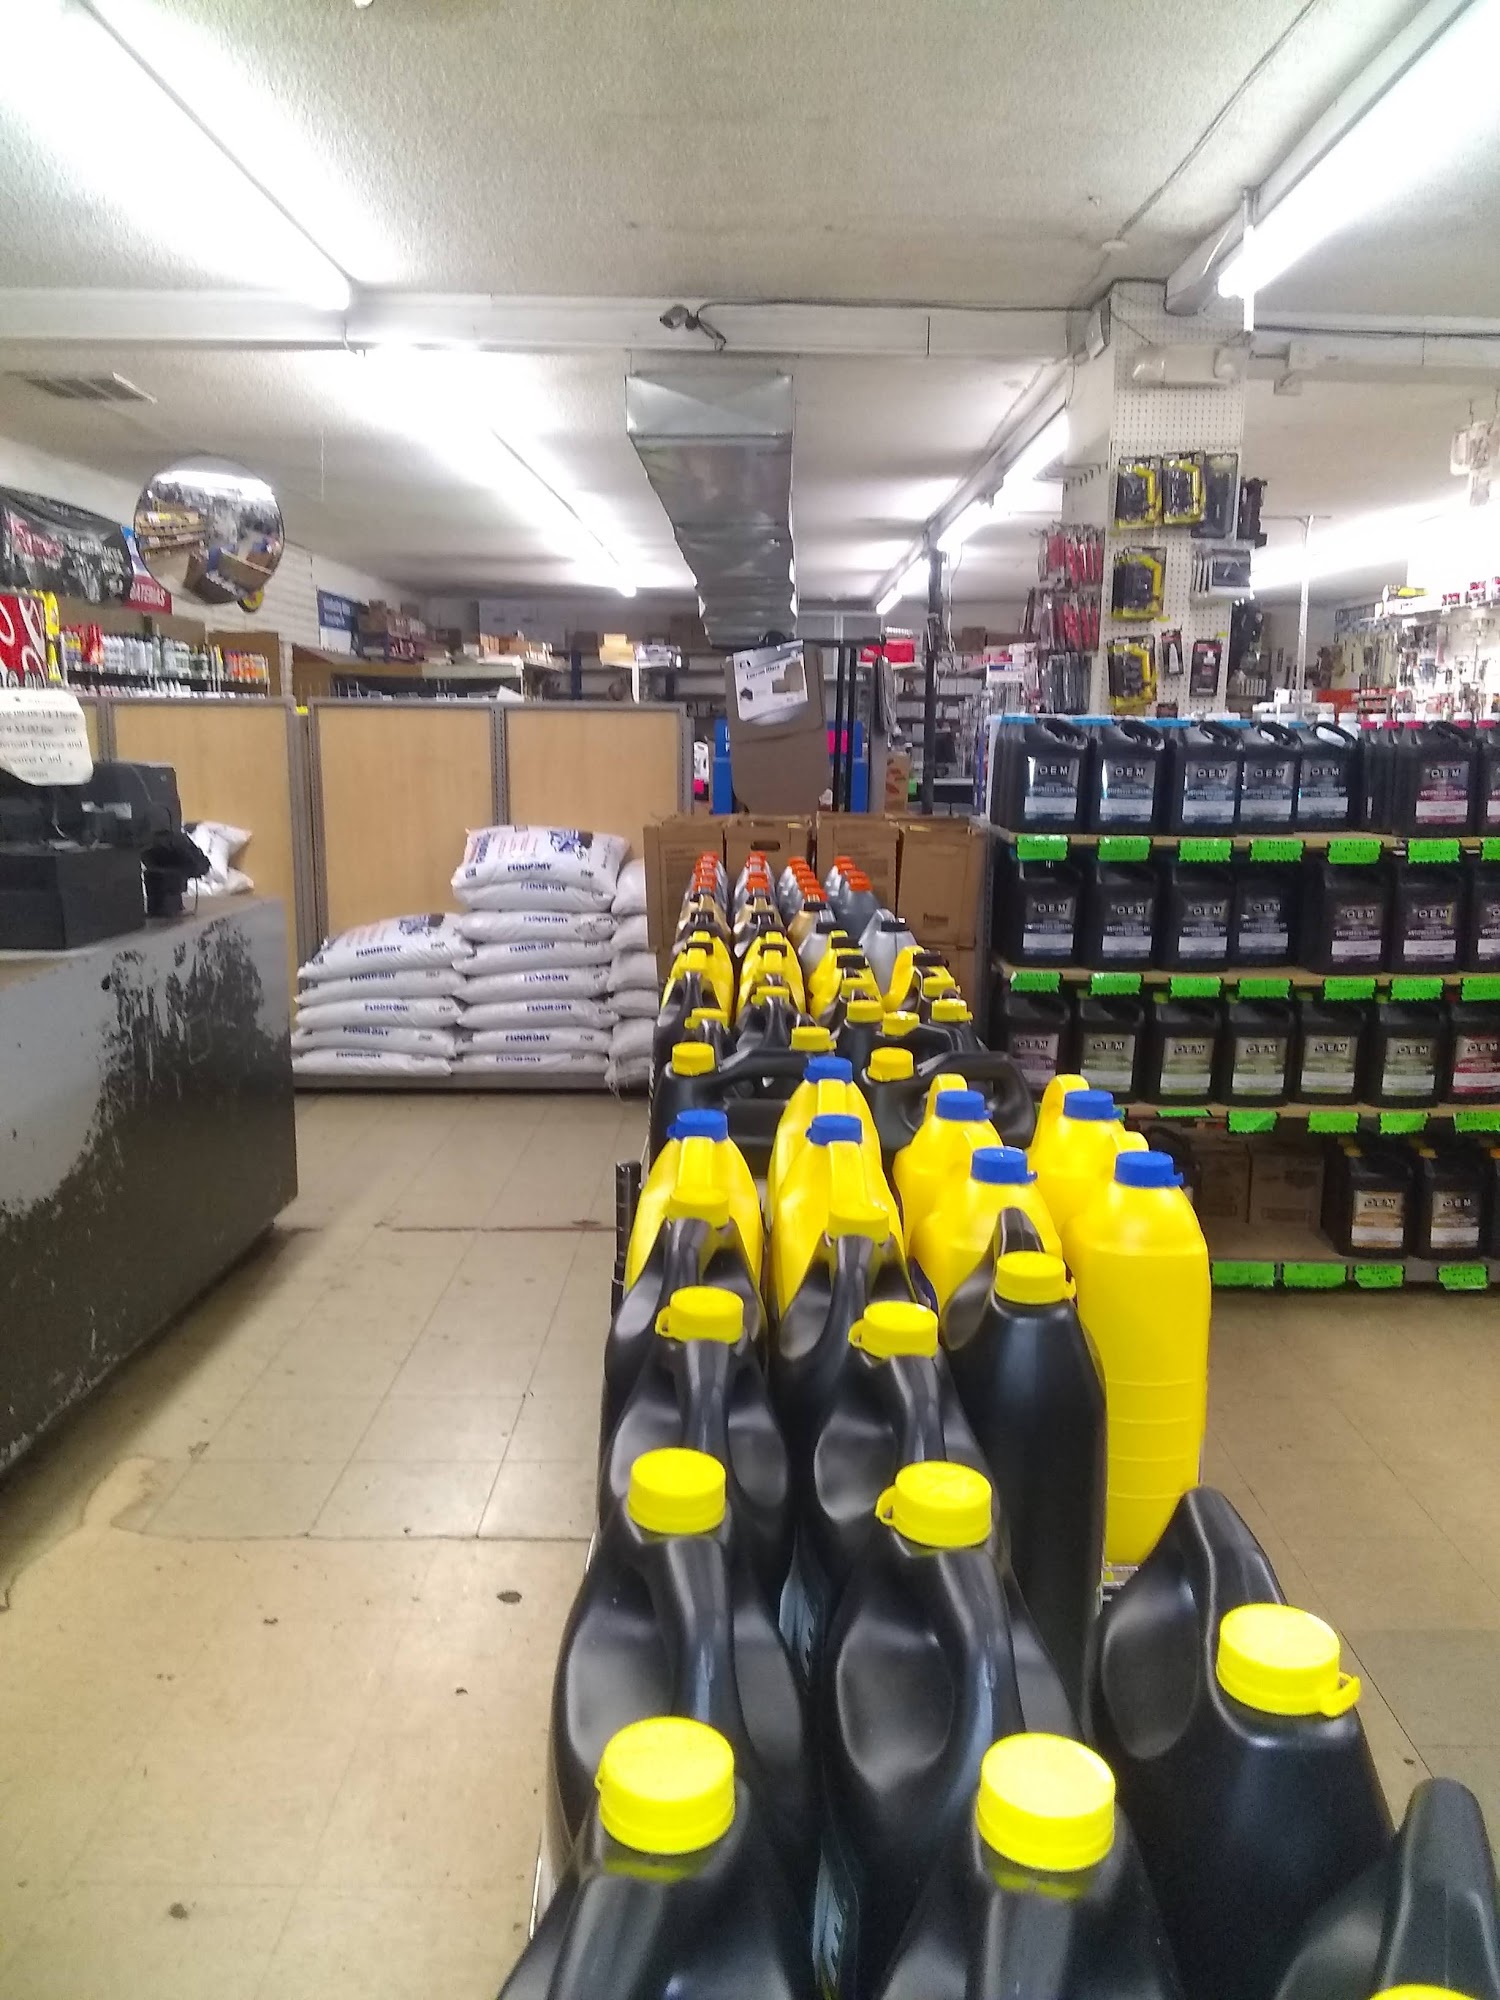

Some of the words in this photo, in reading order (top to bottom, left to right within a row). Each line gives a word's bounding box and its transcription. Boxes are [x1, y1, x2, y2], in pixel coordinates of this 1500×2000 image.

[1039, 765, 1068, 777] OEM
[1115, 767, 1145, 778] OEM
[1197, 768, 1228, 779] OEM
[1255, 768, 1285, 778] OEM
[1311, 766, 1340, 776] OEM
[1431, 769, 1461, 778] OEM
[1037, 903, 1066, 913] OEM
[1117, 906, 1145, 915] OEM
[1346, 909, 1375, 919] OEM
[1418, 909, 1448, 918] OEM
